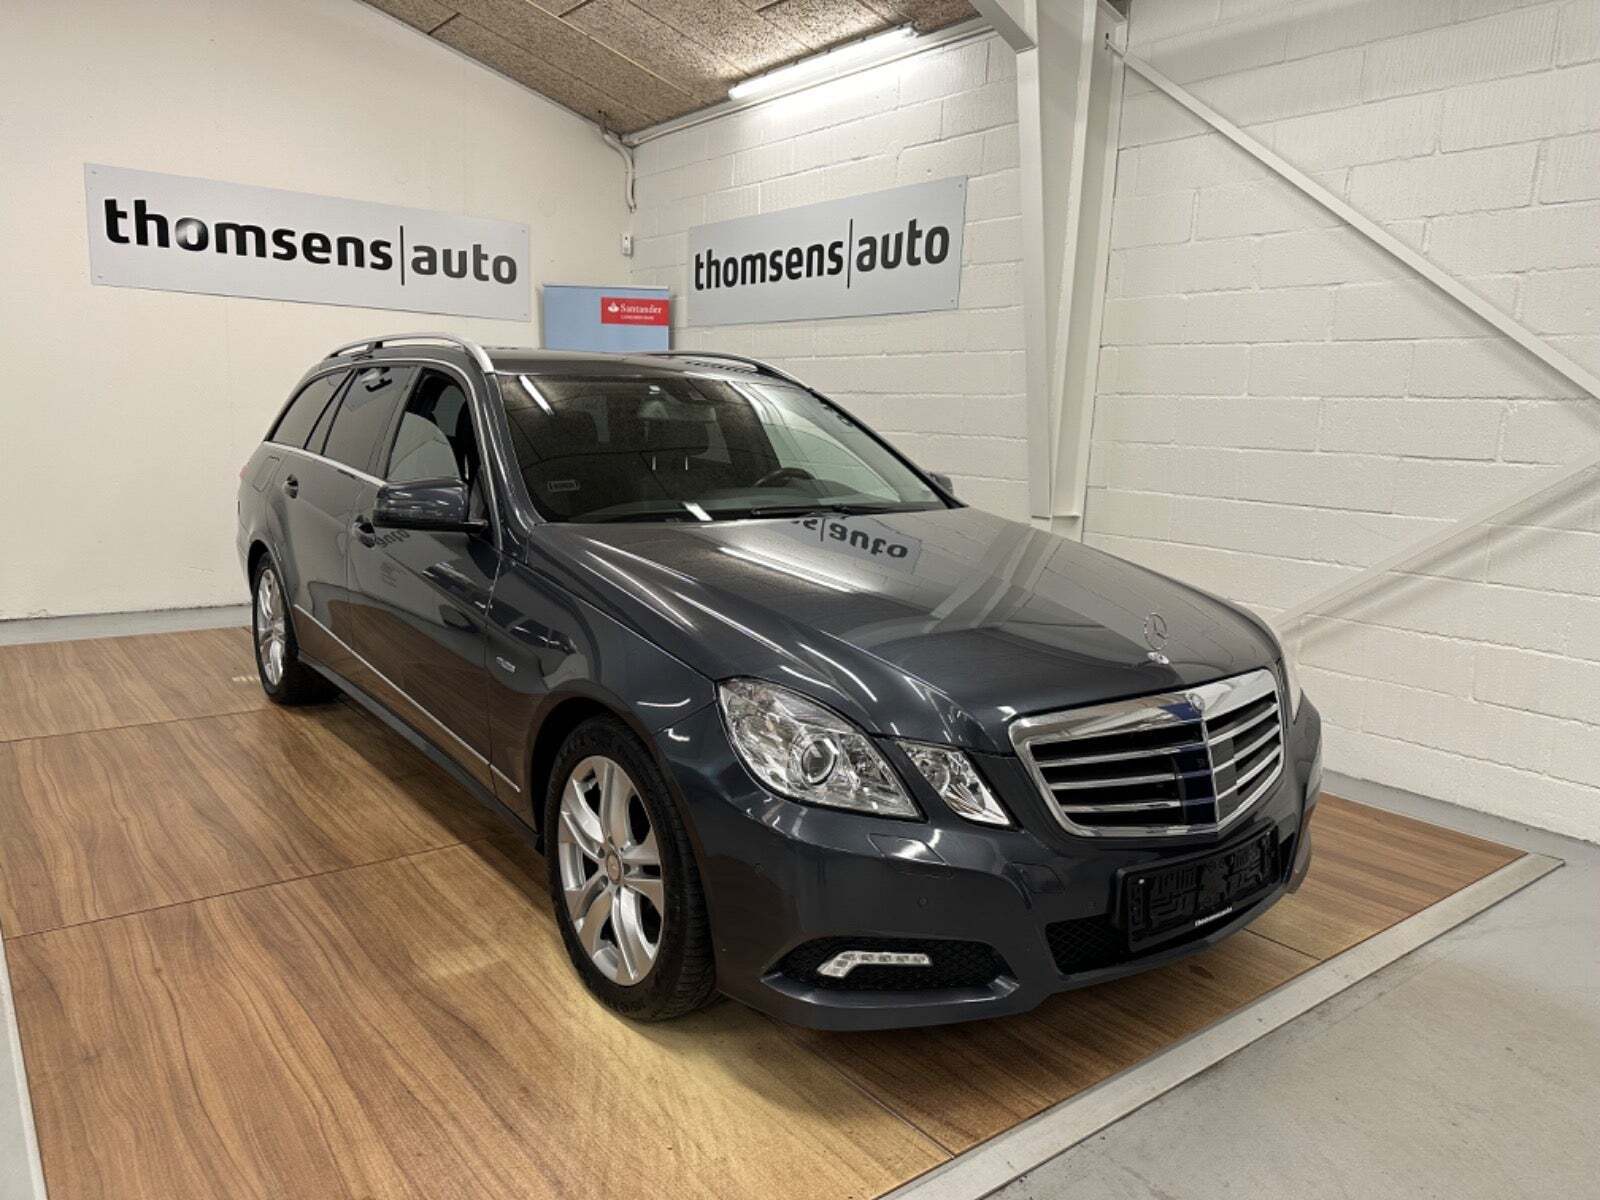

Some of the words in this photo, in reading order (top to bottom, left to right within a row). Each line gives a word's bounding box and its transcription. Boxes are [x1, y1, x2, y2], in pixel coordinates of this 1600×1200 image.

[105, 199, 393, 271] thomsens
[411, 243, 517, 284] auto
[694, 240, 844, 291] thomsens
[856, 218, 950, 272] auto
[620, 303, 662, 314] Santander
